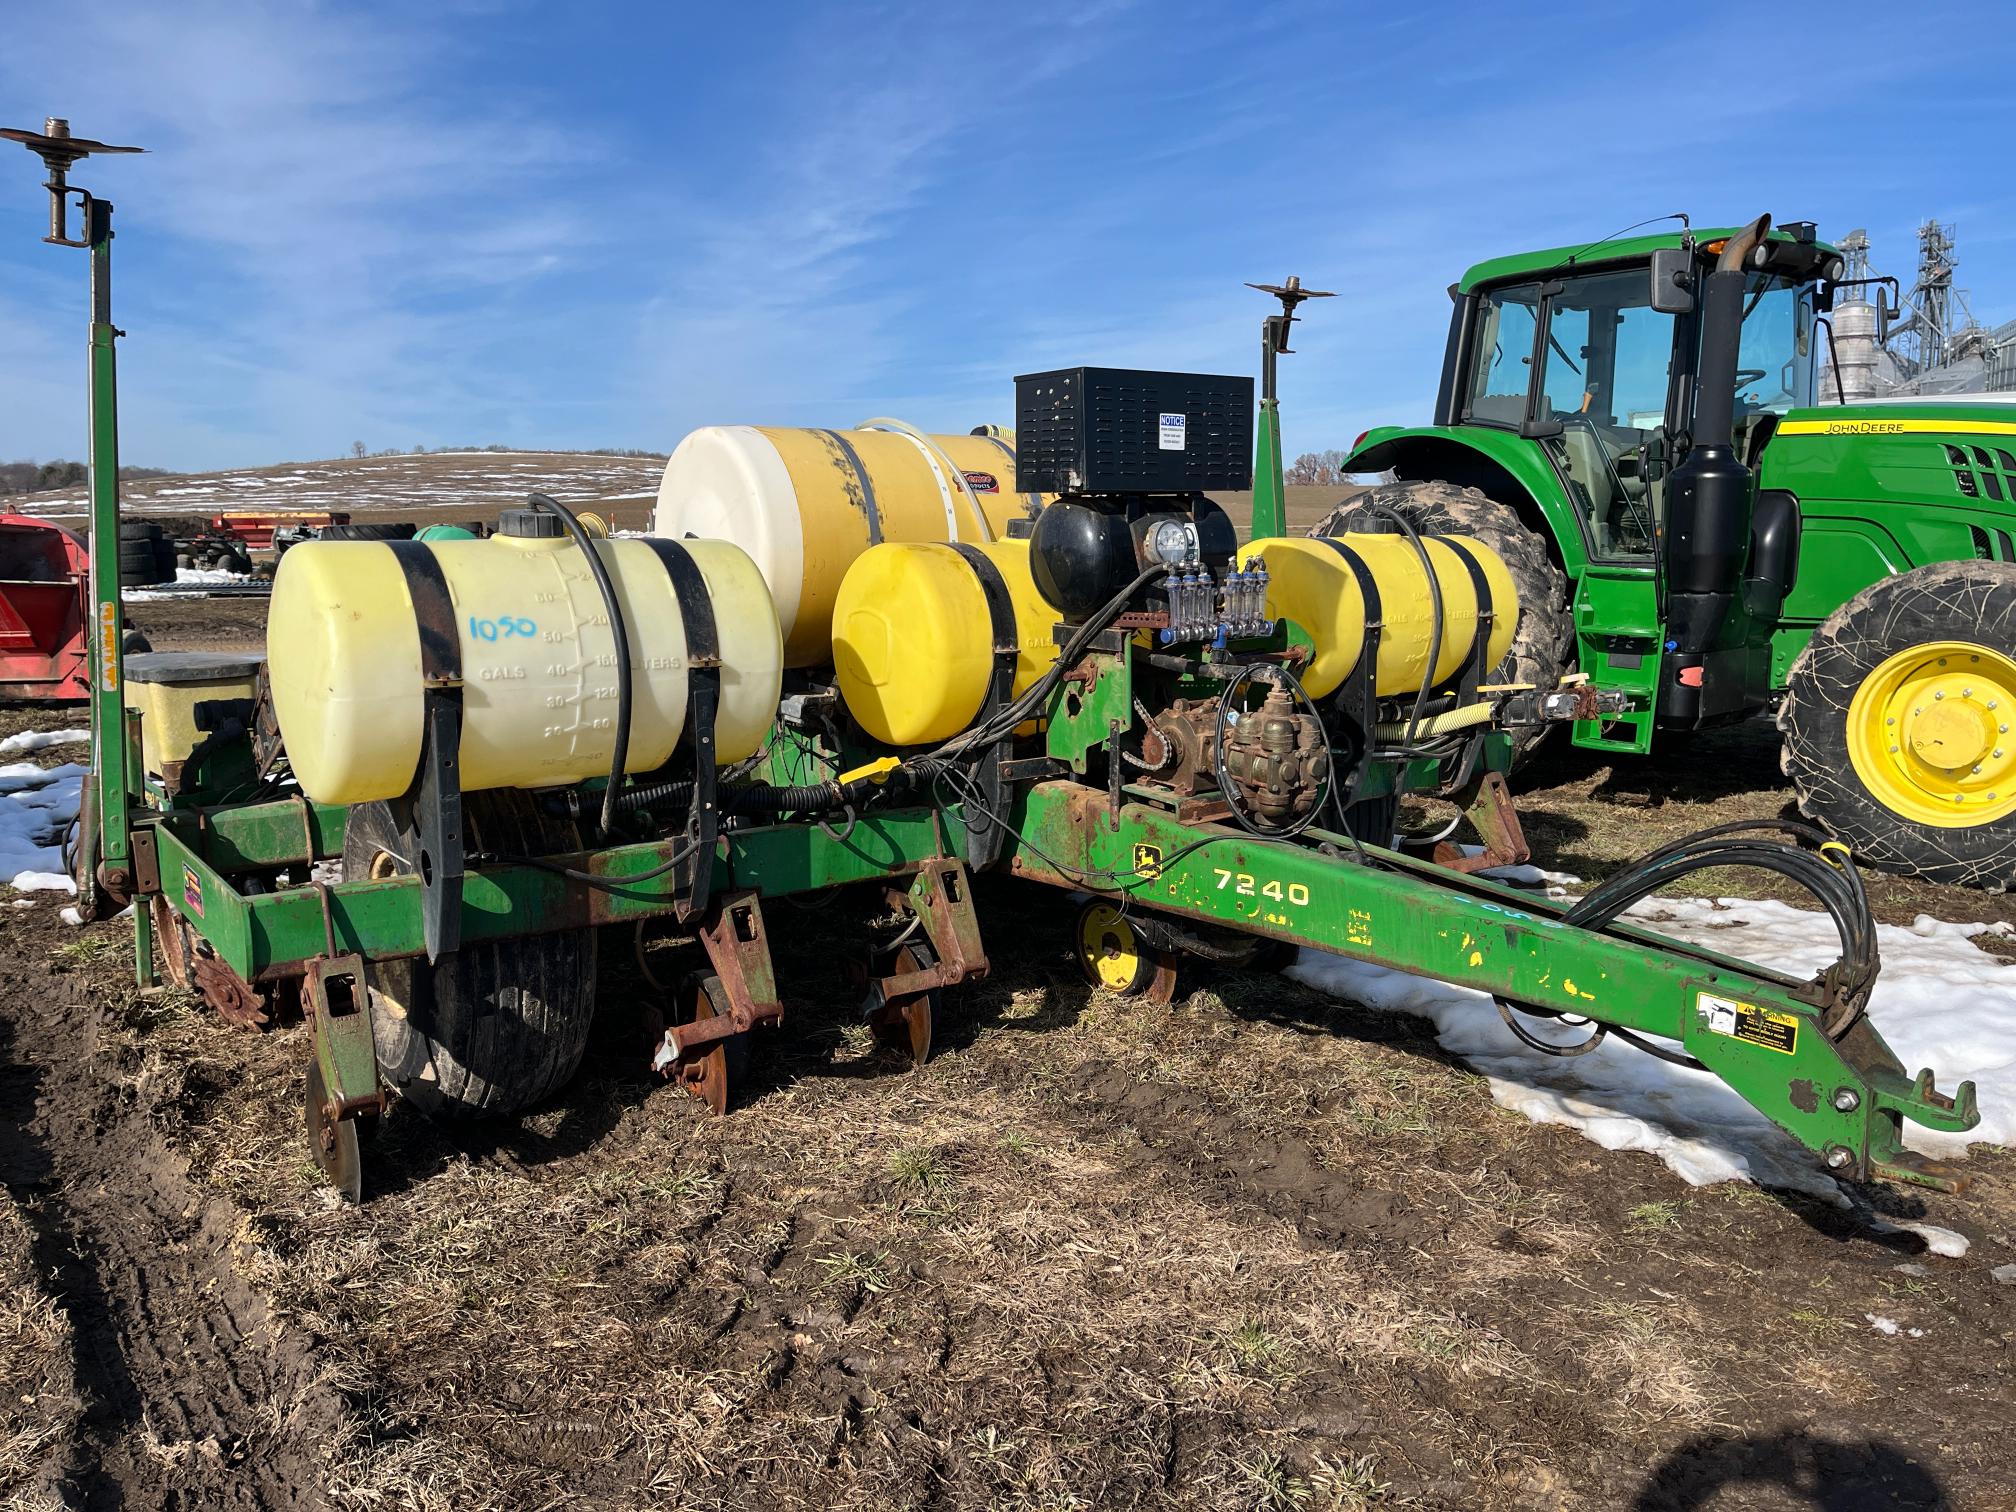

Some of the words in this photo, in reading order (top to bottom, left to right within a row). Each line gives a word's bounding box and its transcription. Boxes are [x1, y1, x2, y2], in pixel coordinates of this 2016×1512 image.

[1161, 416, 1184, 426] NOTICE
[1825, 423, 1859, 433] JOHN
[1861, 422, 1904, 432] DEERE
[469, 616, 538, 642] 1050
[543, 632, 562, 643] 50
[479, 666, 527, 681] GALS
[546, 664, 566, 676] 40
[594, 688, 618, 700] 120
[1213, 868, 1309, 906] 7240
